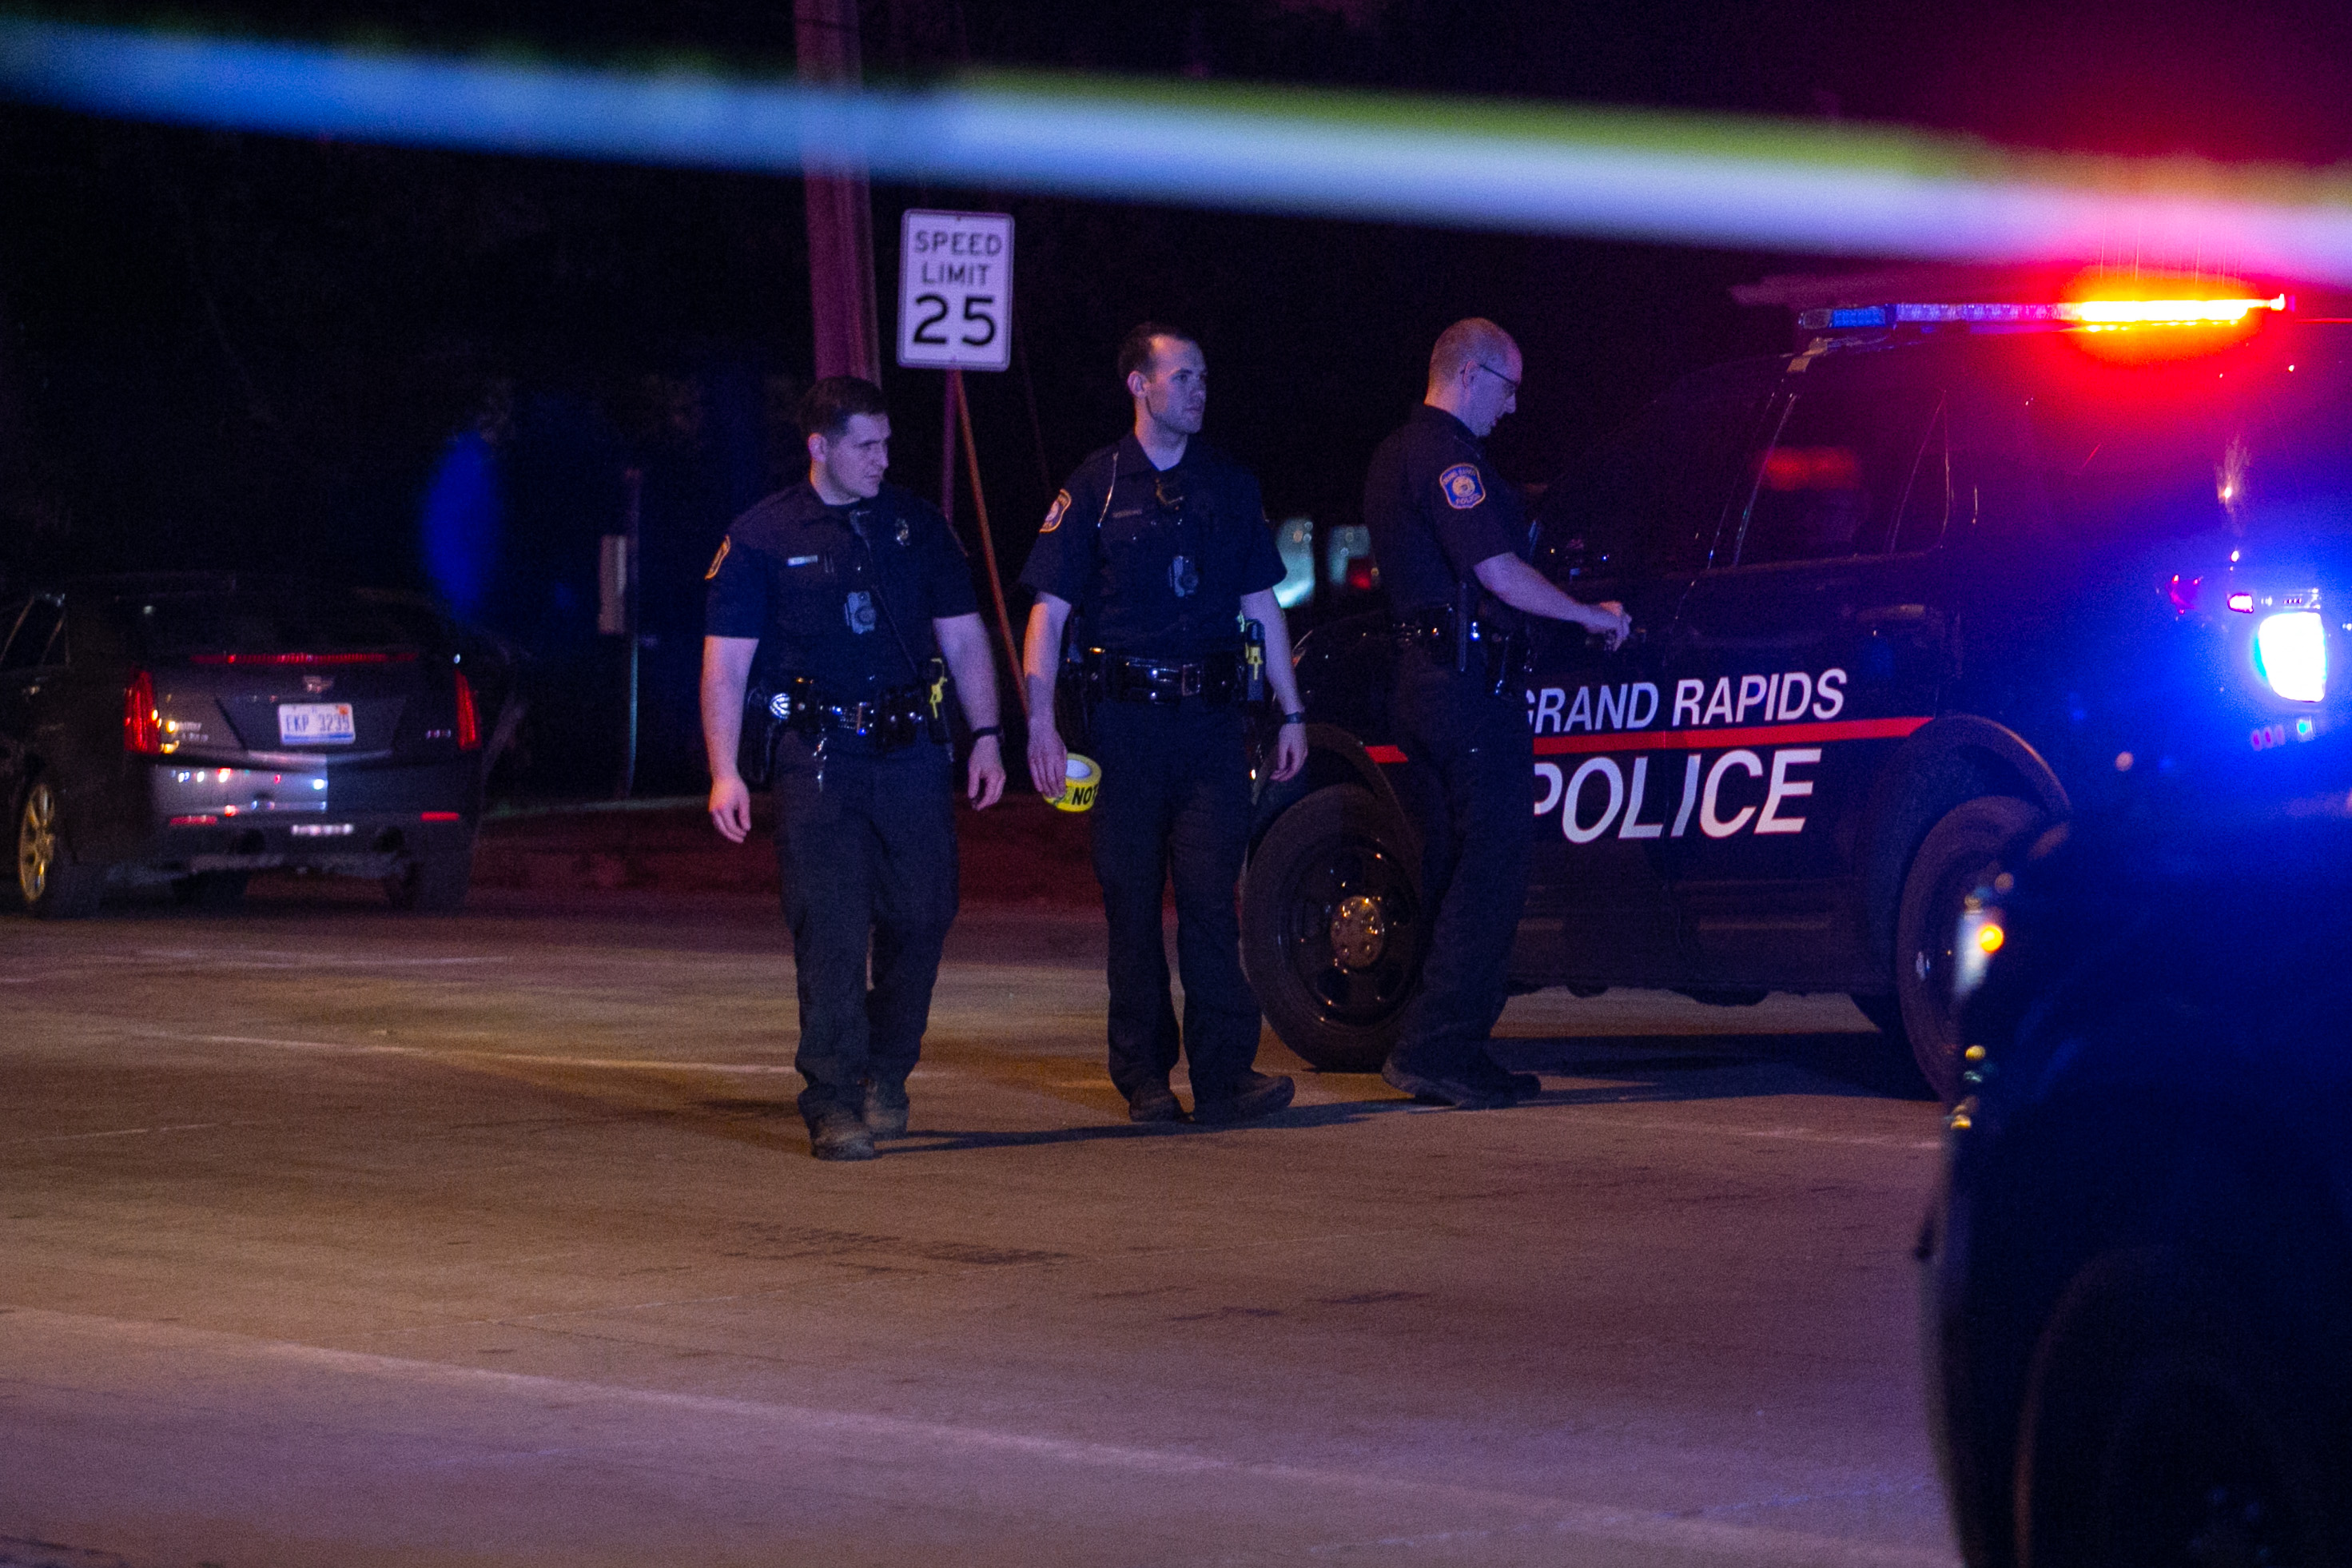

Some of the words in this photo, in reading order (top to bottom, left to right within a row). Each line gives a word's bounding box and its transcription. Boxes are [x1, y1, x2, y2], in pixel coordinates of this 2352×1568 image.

[915, 231, 1001, 255] SPEED
[922, 262, 989, 285] LIMIT
[914, 294, 995, 345] 25
[1672, 668, 1849, 726] RAPIDS
